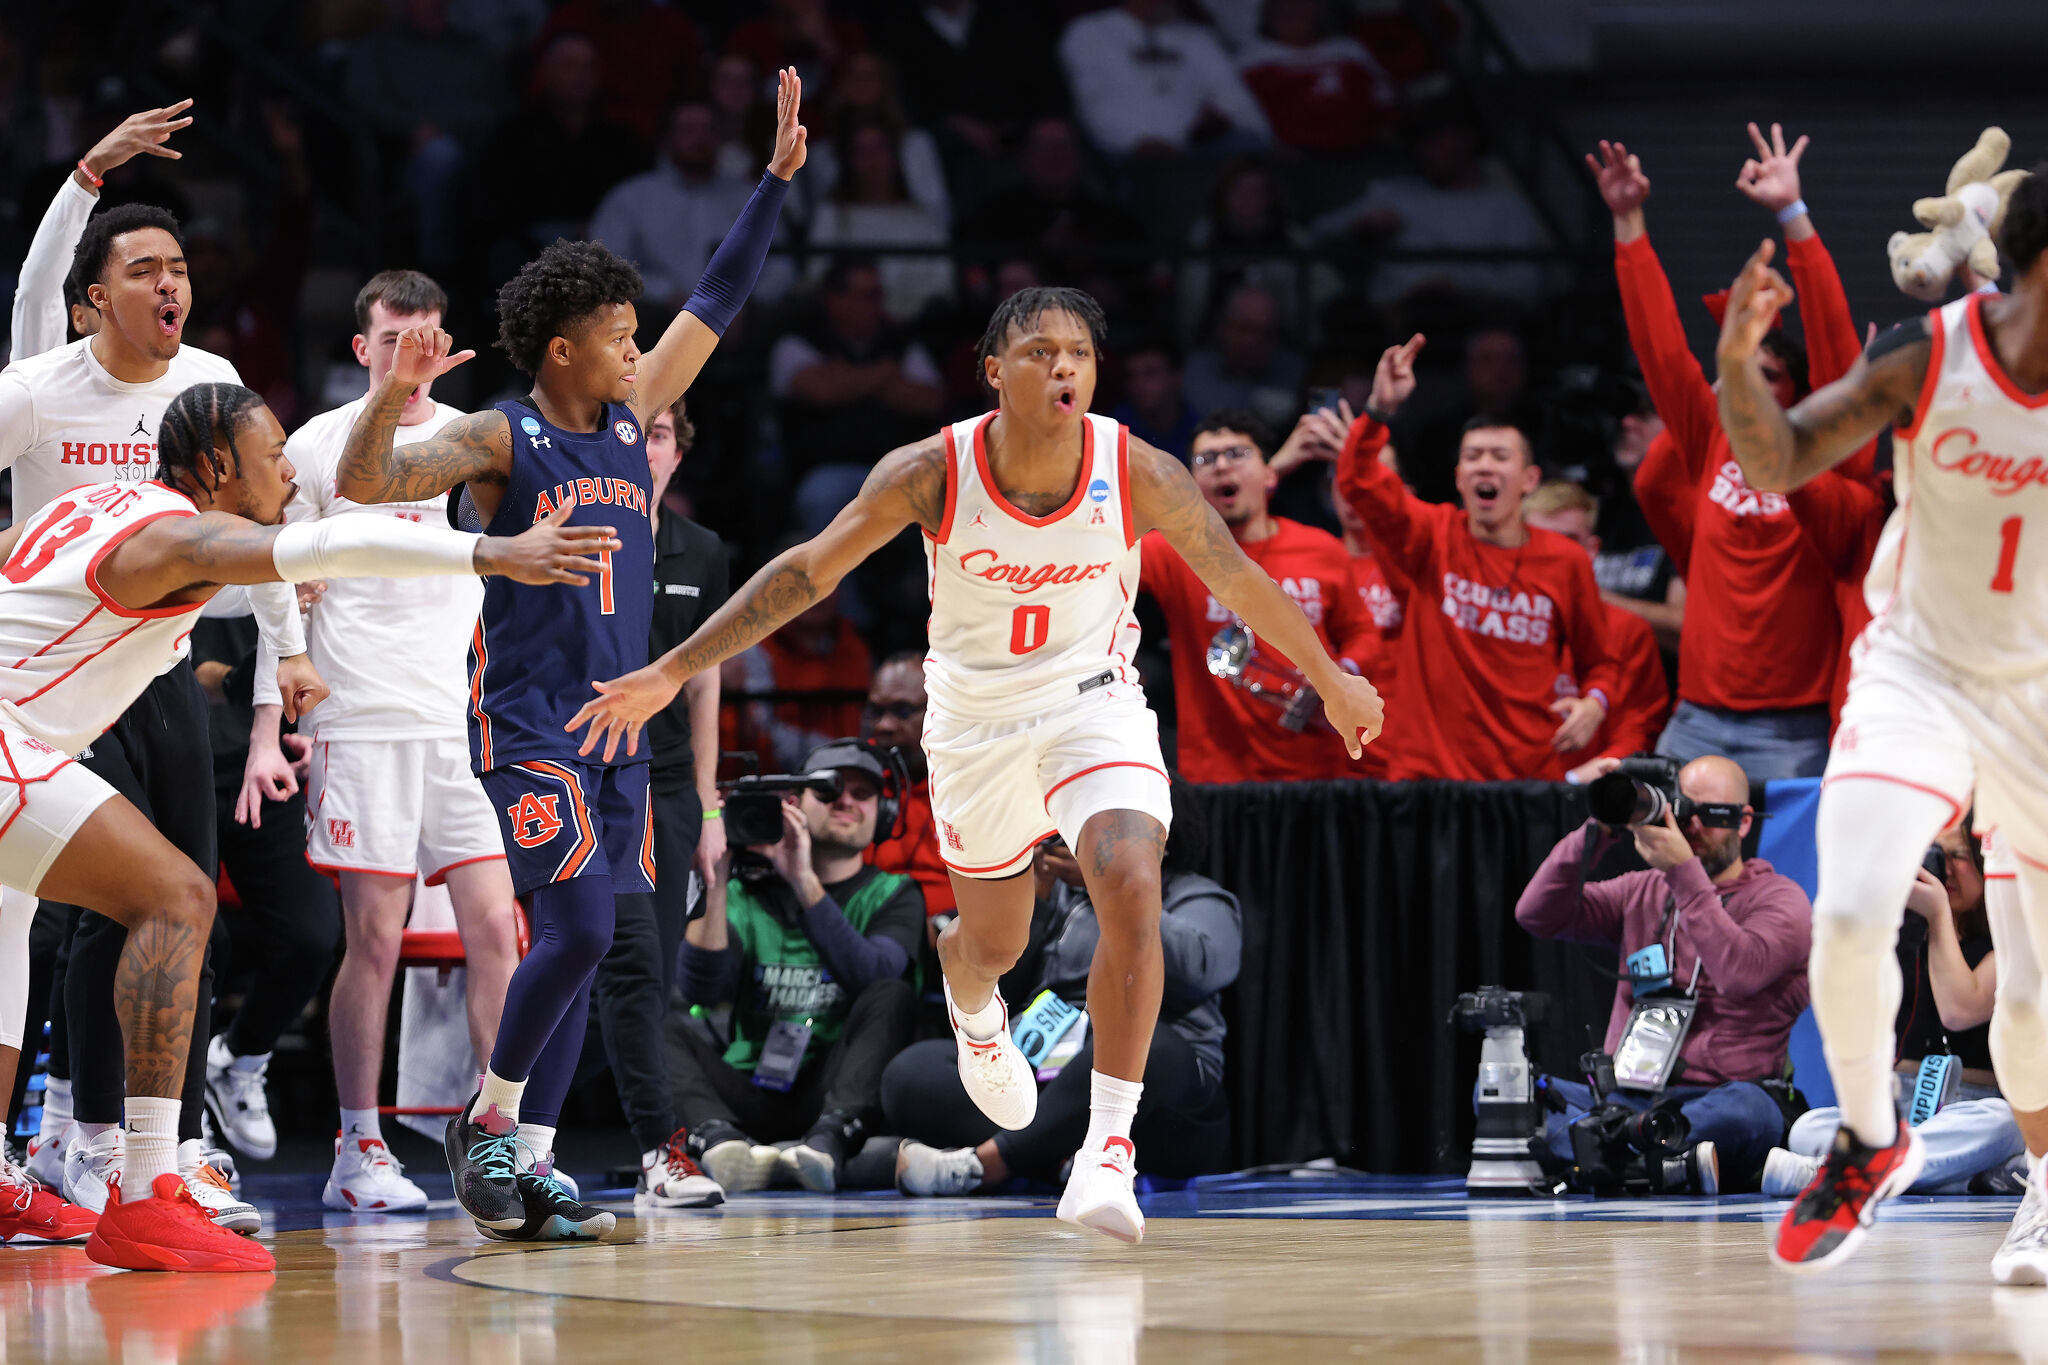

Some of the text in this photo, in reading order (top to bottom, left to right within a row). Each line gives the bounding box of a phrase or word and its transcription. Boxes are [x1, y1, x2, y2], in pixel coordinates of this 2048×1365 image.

[533, 477, 647, 524] AUBURN
[0, 500, 93, 584] 13
[1990, 514, 2023, 593] 1
[960, 549, 1112, 594] Cougars
[1010, 605, 1051, 655] 0
